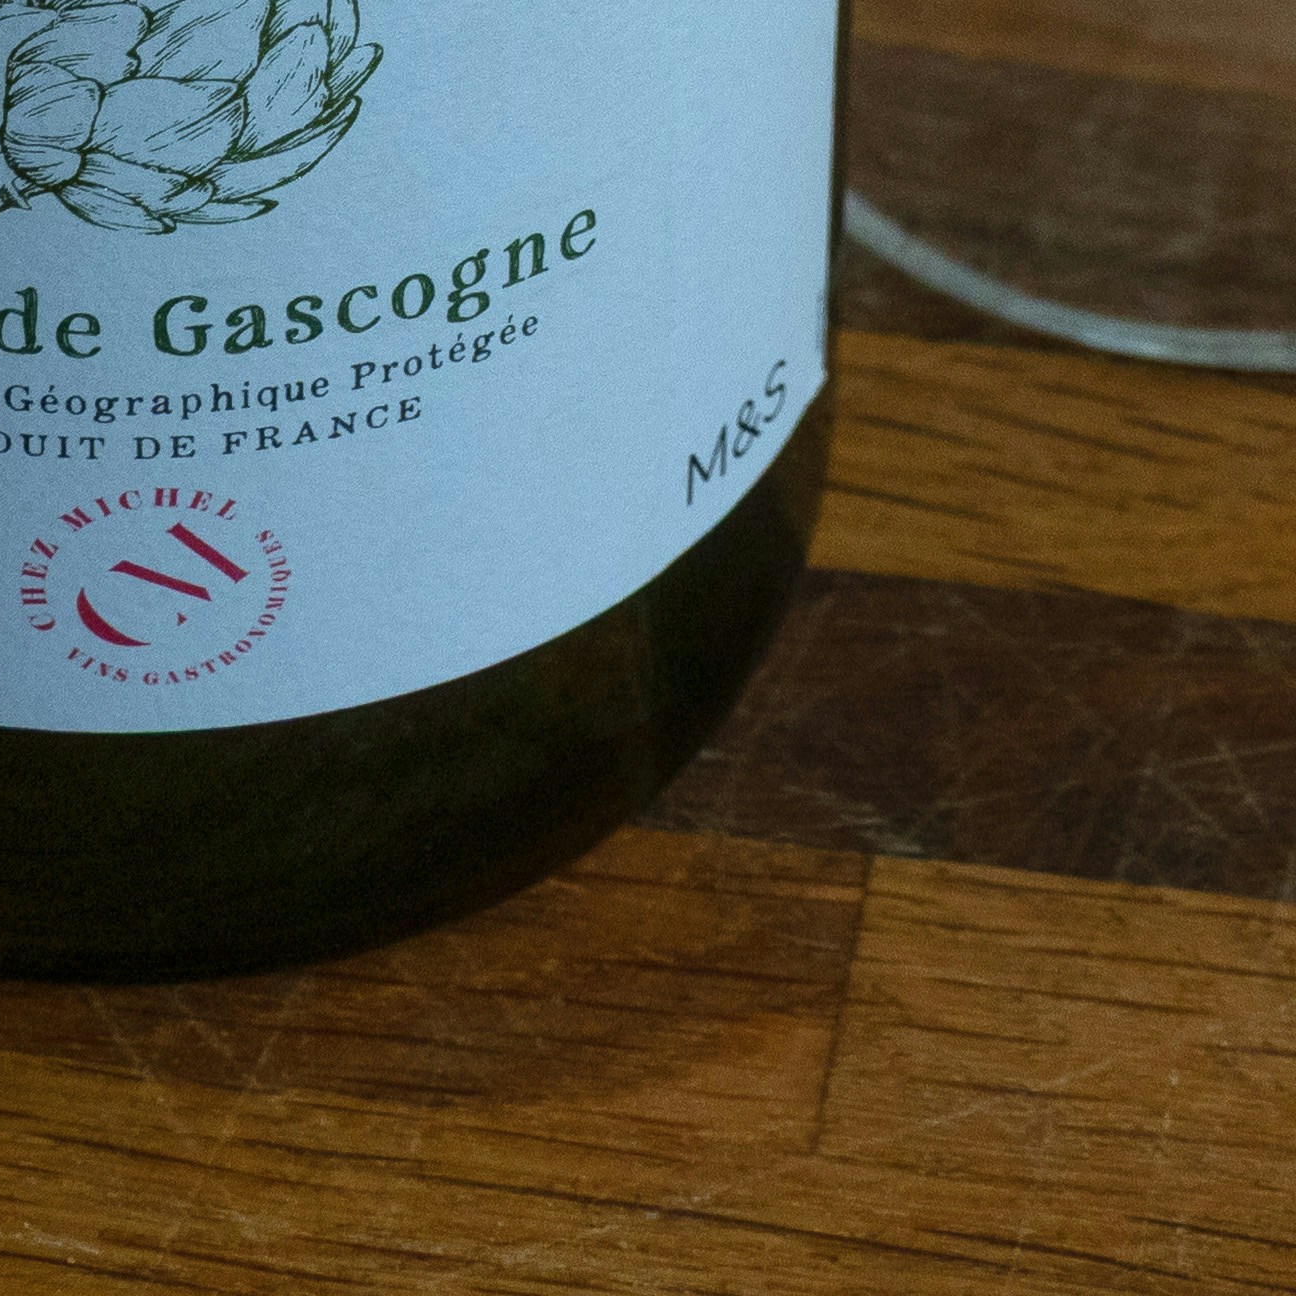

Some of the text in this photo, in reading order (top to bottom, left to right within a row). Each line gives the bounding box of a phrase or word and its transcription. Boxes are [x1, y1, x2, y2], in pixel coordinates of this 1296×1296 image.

[152, 207, 598, 358] Gascogne
[3, 375, 330, 424] Géographique
[350, 314, 540, 391] Protégée
[132, 434, 197, 460] DE
[221, 395, 424, 456] FRANCE
[685, 358, 787, 507] M&S
[20, 487, 237, 632] CHEZ MICHEL
